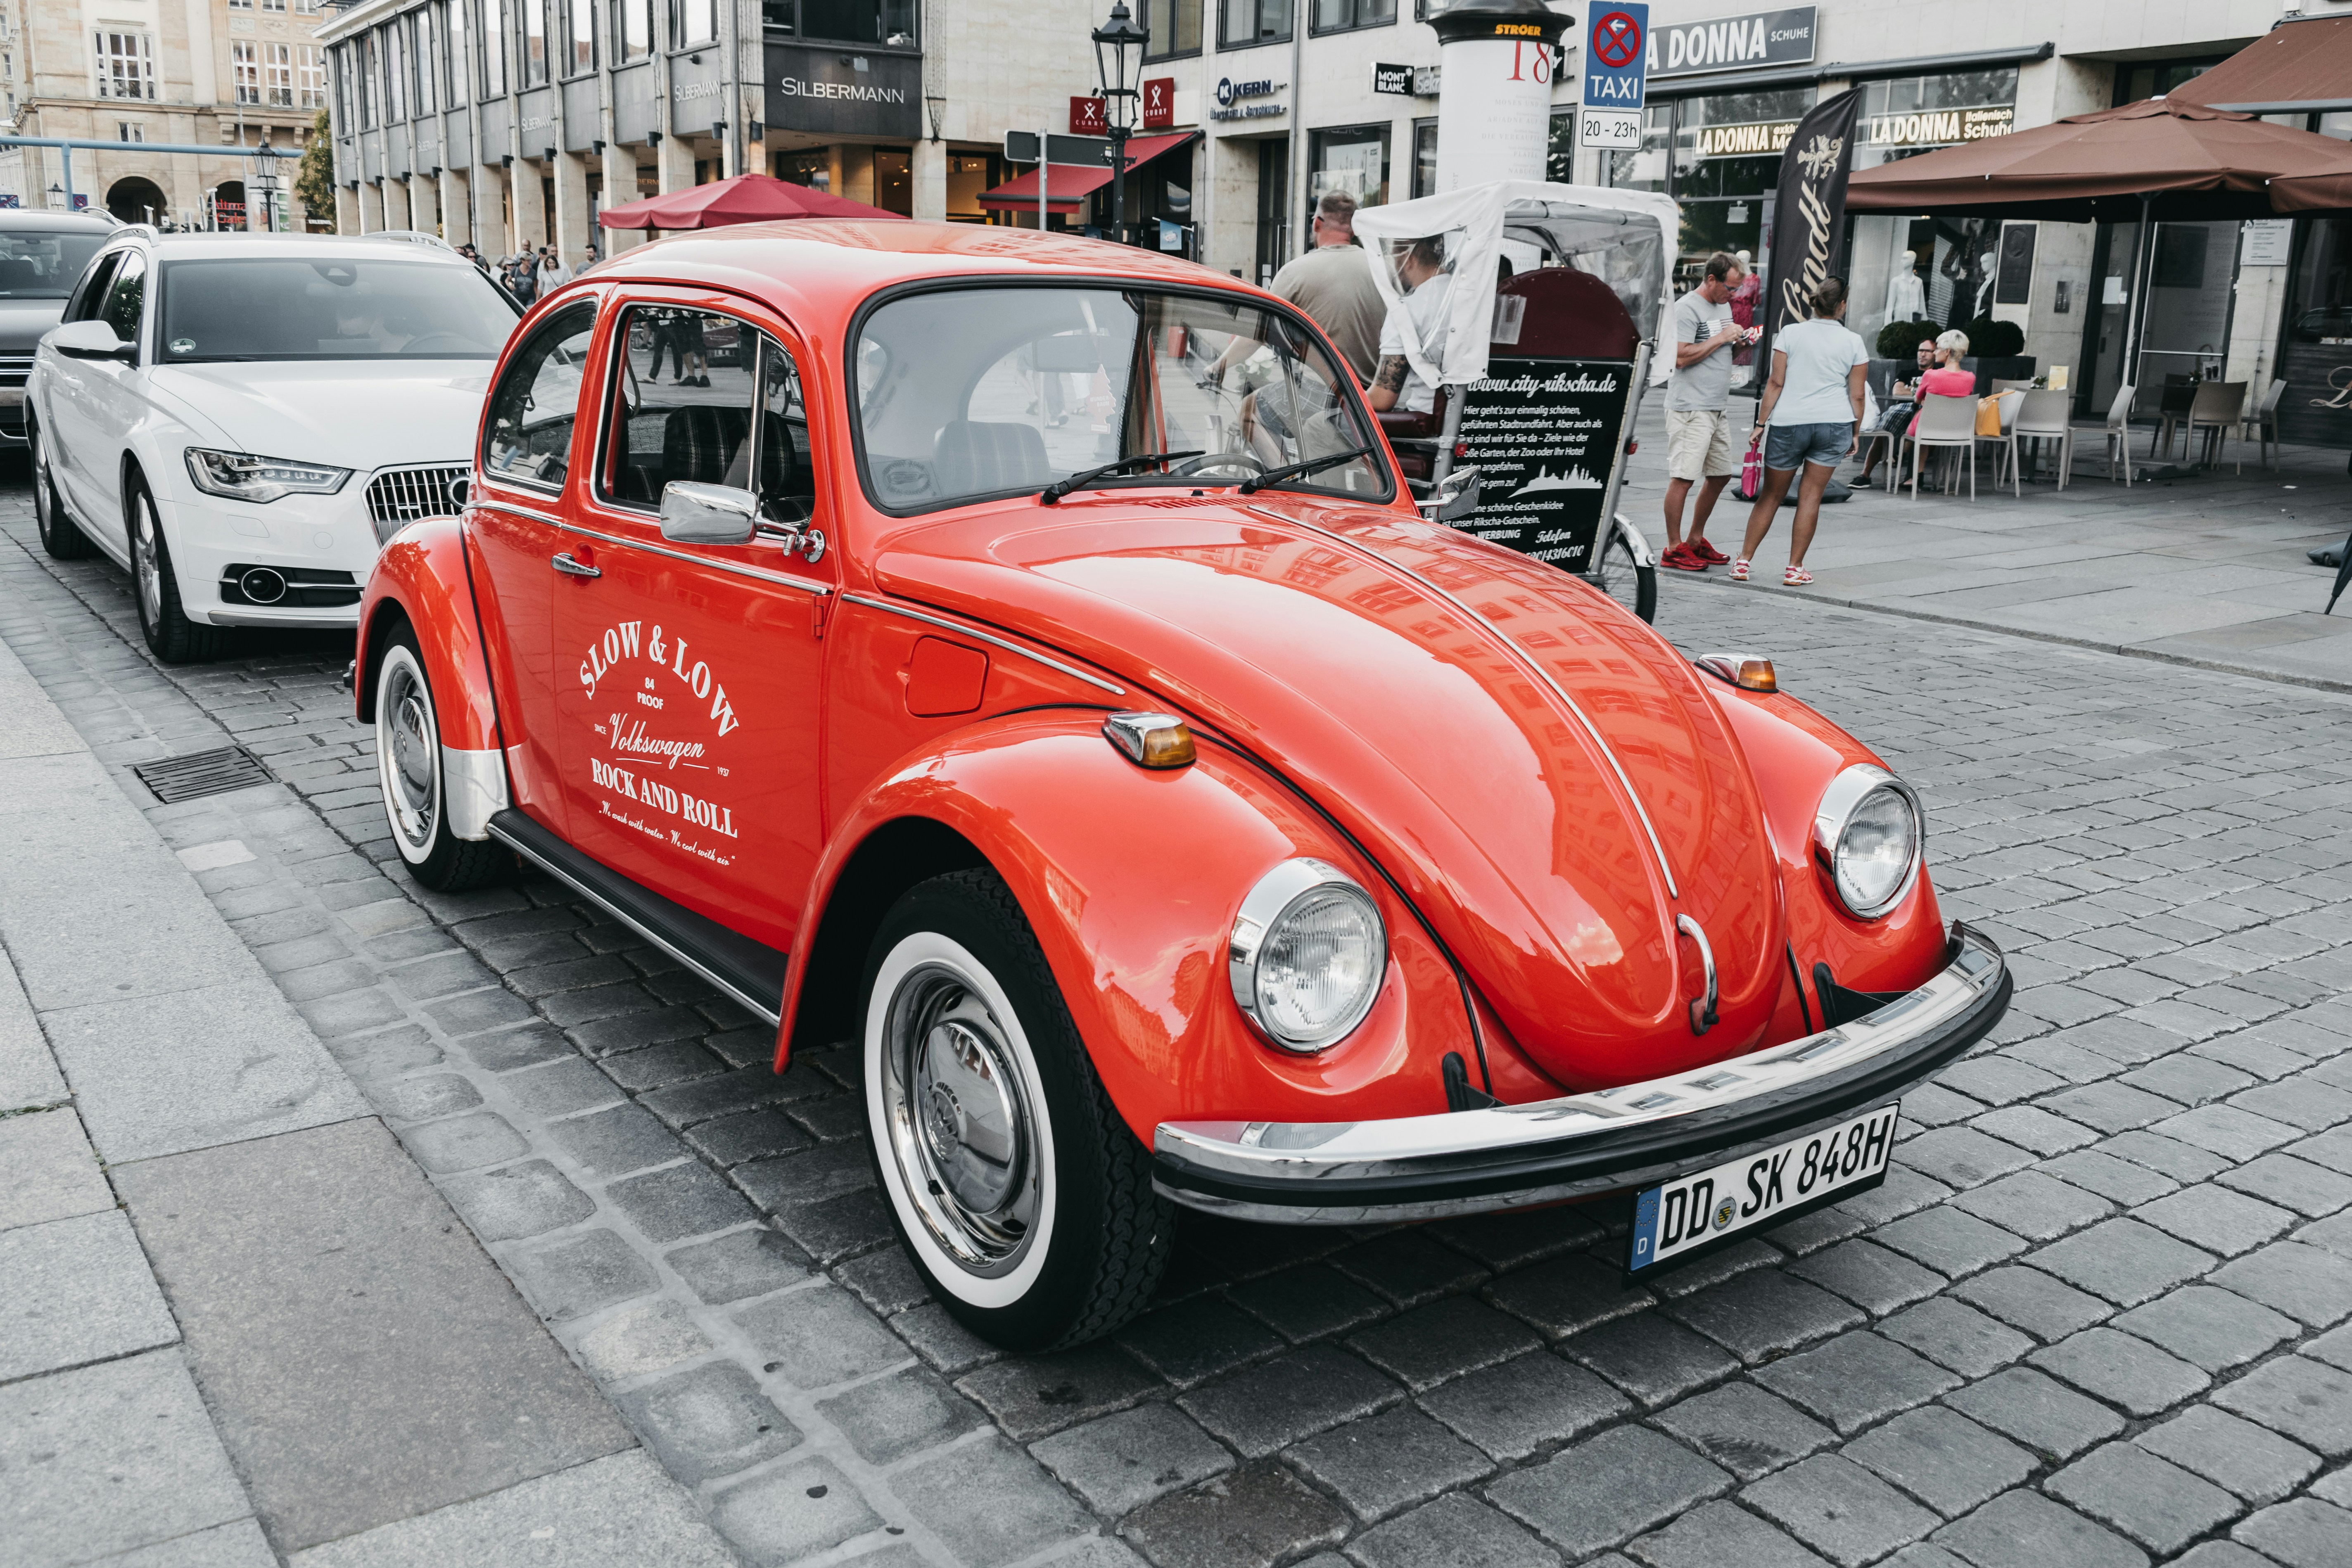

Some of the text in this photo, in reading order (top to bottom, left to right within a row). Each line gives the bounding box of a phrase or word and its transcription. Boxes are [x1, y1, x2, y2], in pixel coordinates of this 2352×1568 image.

[1668, 18, 1767, 69] DONNA
[1771, 27, 1809, 42] SCHUHE
[1378, 71, 1405, 83] MONT
[1234, 80, 1271, 96] KERN
[1378, 81, 1405, 93] BLANC
[1590, 75, 1638, 99] TAXI
[1145, 108, 1167, 117] CURRY
[1585, 121, 1600, 136] 20
[1614, 122, 1637, 138] 23h
[1871, 112, 1960, 144] LA DONNA
[1696, 125, 1769, 154] LA DONNA
[1467, 372, 1617, 398] www.city-rikscha.de
[1463, 406, 1480, 415] Hier
[1480, 406, 1503, 416] geht's
[1517, 406, 1548, 416] einmalig
[1549, 406, 1581, 415] schönen,
[1460, 419, 1602, 431] geführten Stadtrundfahrt. Aber auch als
[1474, 434, 1491, 443] sind
[1491, 434, 1504, 443] wir
[1504, 434, 1516, 443] für
[1516, 434, 1527, 443] Sie
[1528, 434, 1538, 442] da
[1543, 434, 1562, 442] Ziele
[1563, 433, 1576, 442] wie
[1576, 433, 1589, 441] der
[1480, 448, 1507, 458] Garten,
[1507, 448, 1520, 456] der
[1521, 448, 1536, 456] Zoo
[1536, 447, 1553, 456] oder
[1565, 447, 1585, 455] Hotel
[1482, 461, 1525, 473] angefahren.
[1487, 503, 1513, 512] schöne
[1514, 501, 1564, 511] Geschenkidee
[1474, 515, 1540, 527] Rikscha-Gutschein.
[1478, 529, 1521, 540] WERBUNG
[580, 621, 739, 737] SLOW & LOW
[645, 677, 655, 690] 84
[637, 692, 664, 709] PROOF
[594, 723, 607, 735] SINCE
[609, 712, 705, 769] Volkswagen
[717, 766, 730, 777] 1937
[591, 757, 738, 838] ROCK AND ROLL
[612, 812, 628, 824] wash
[628, 819, 643, 831] with
[644, 828, 664, 840] water
[670, 829, 681, 847] We
[682, 841, 698, 854] cool
[698, 848, 716, 861] with
[1659, 1178, 1714, 1250] DD
[1741, 1148, 1792, 1218] SK
[1797, 1114, 1891, 1195] 848H
[1637, 1237, 1647, 1255] D
